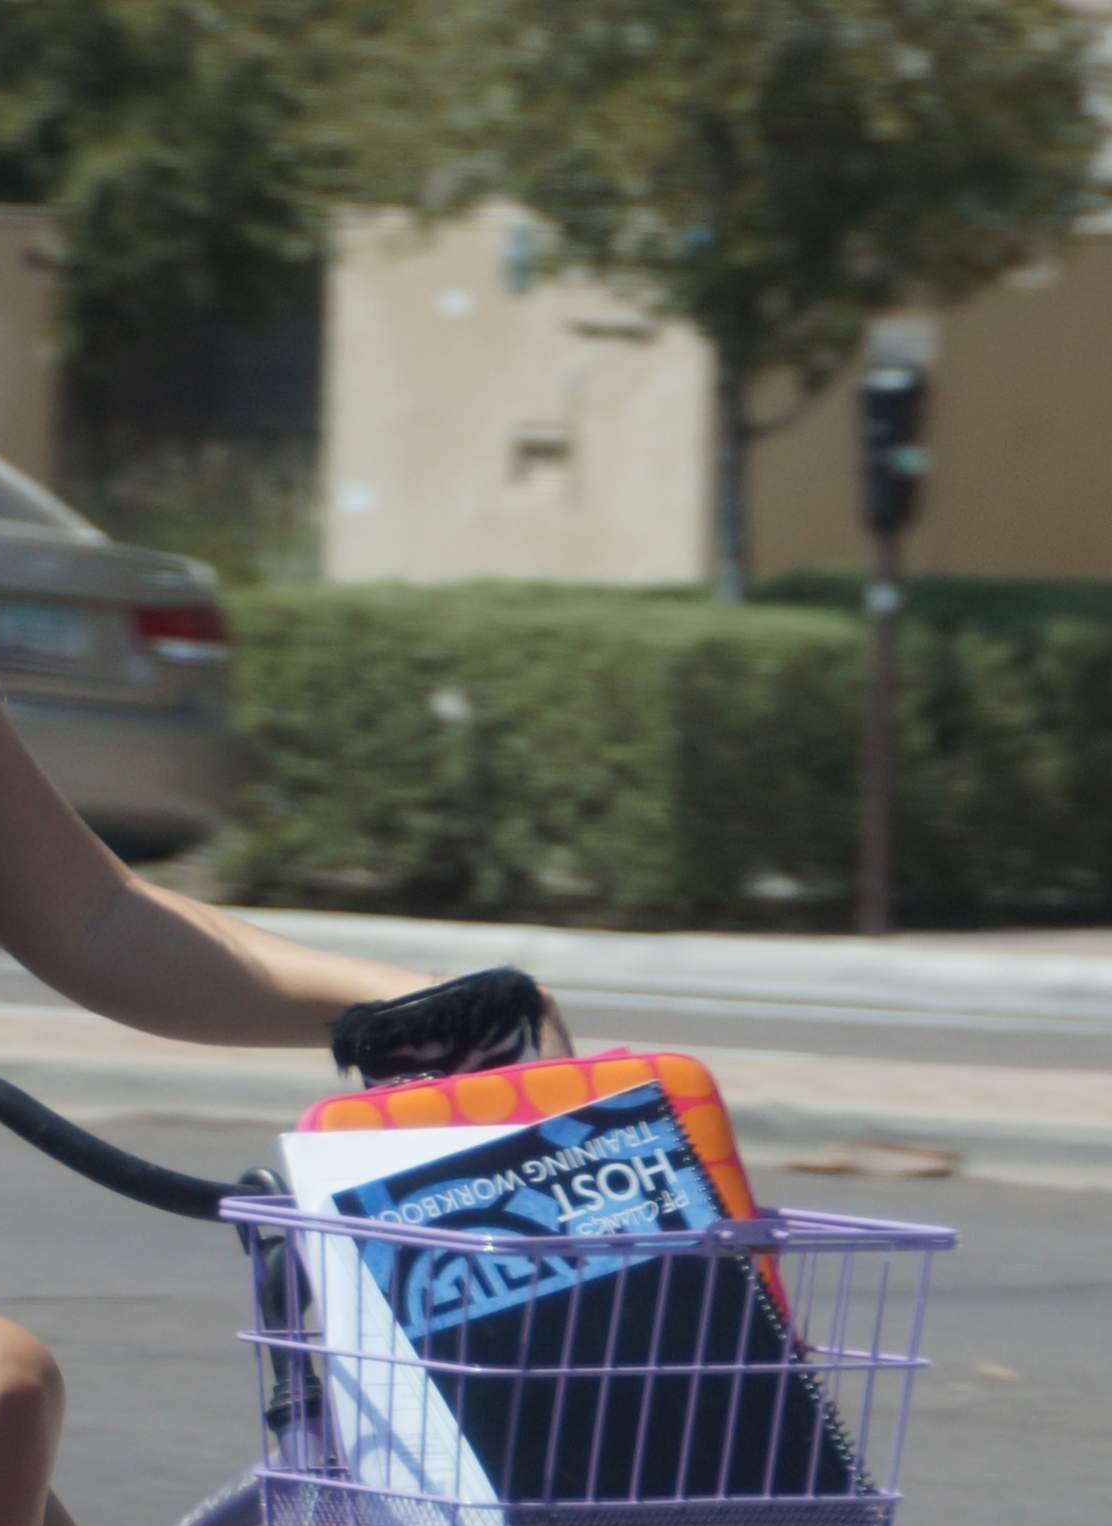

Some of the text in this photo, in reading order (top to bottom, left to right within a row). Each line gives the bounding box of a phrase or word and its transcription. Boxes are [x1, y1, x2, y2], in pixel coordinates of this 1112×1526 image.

[369, 1120, 660, 1224] TRAINING WORKBOO
[551, 1148, 677, 1223] HOST
